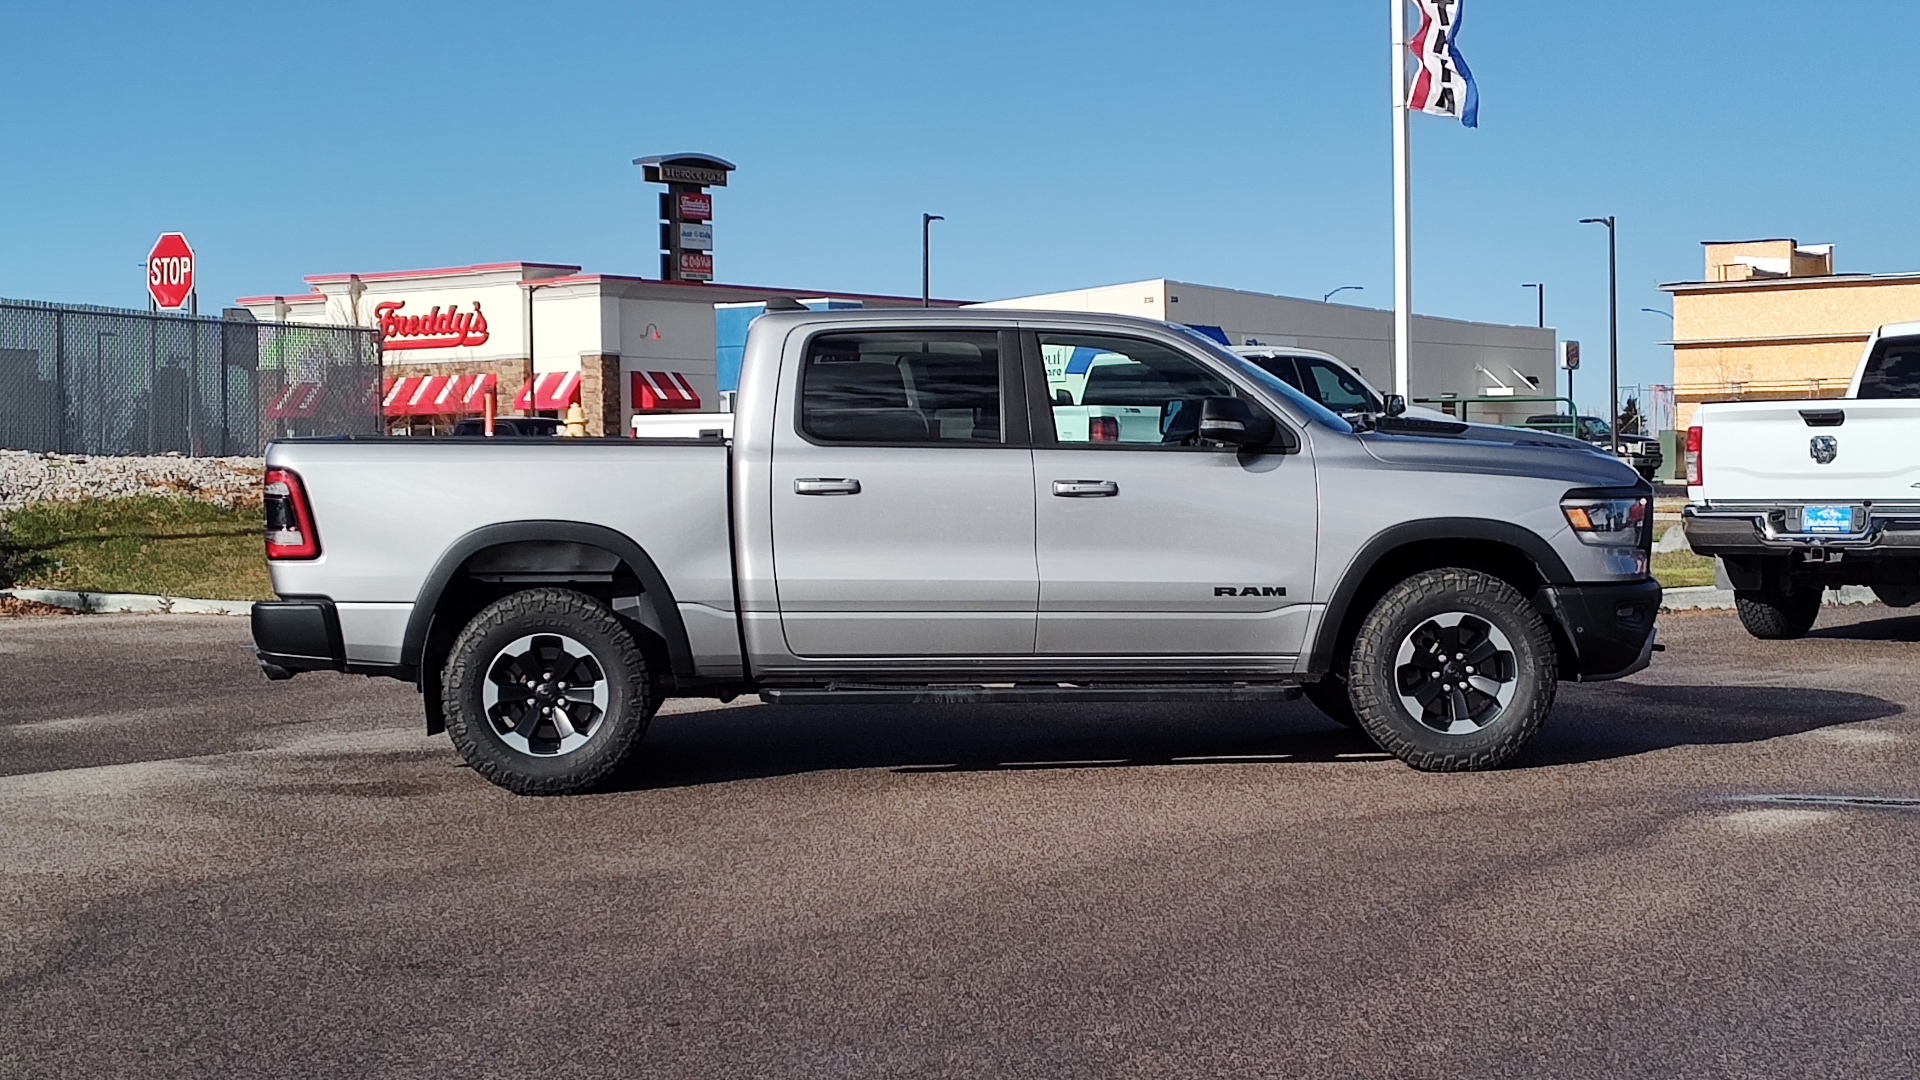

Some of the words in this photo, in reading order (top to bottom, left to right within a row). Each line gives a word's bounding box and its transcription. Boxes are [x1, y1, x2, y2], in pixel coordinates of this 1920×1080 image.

[151, 256, 191, 286] STOP
[375, 300, 489, 350] Freddy's
[1214, 587, 1287, 596] RAM
